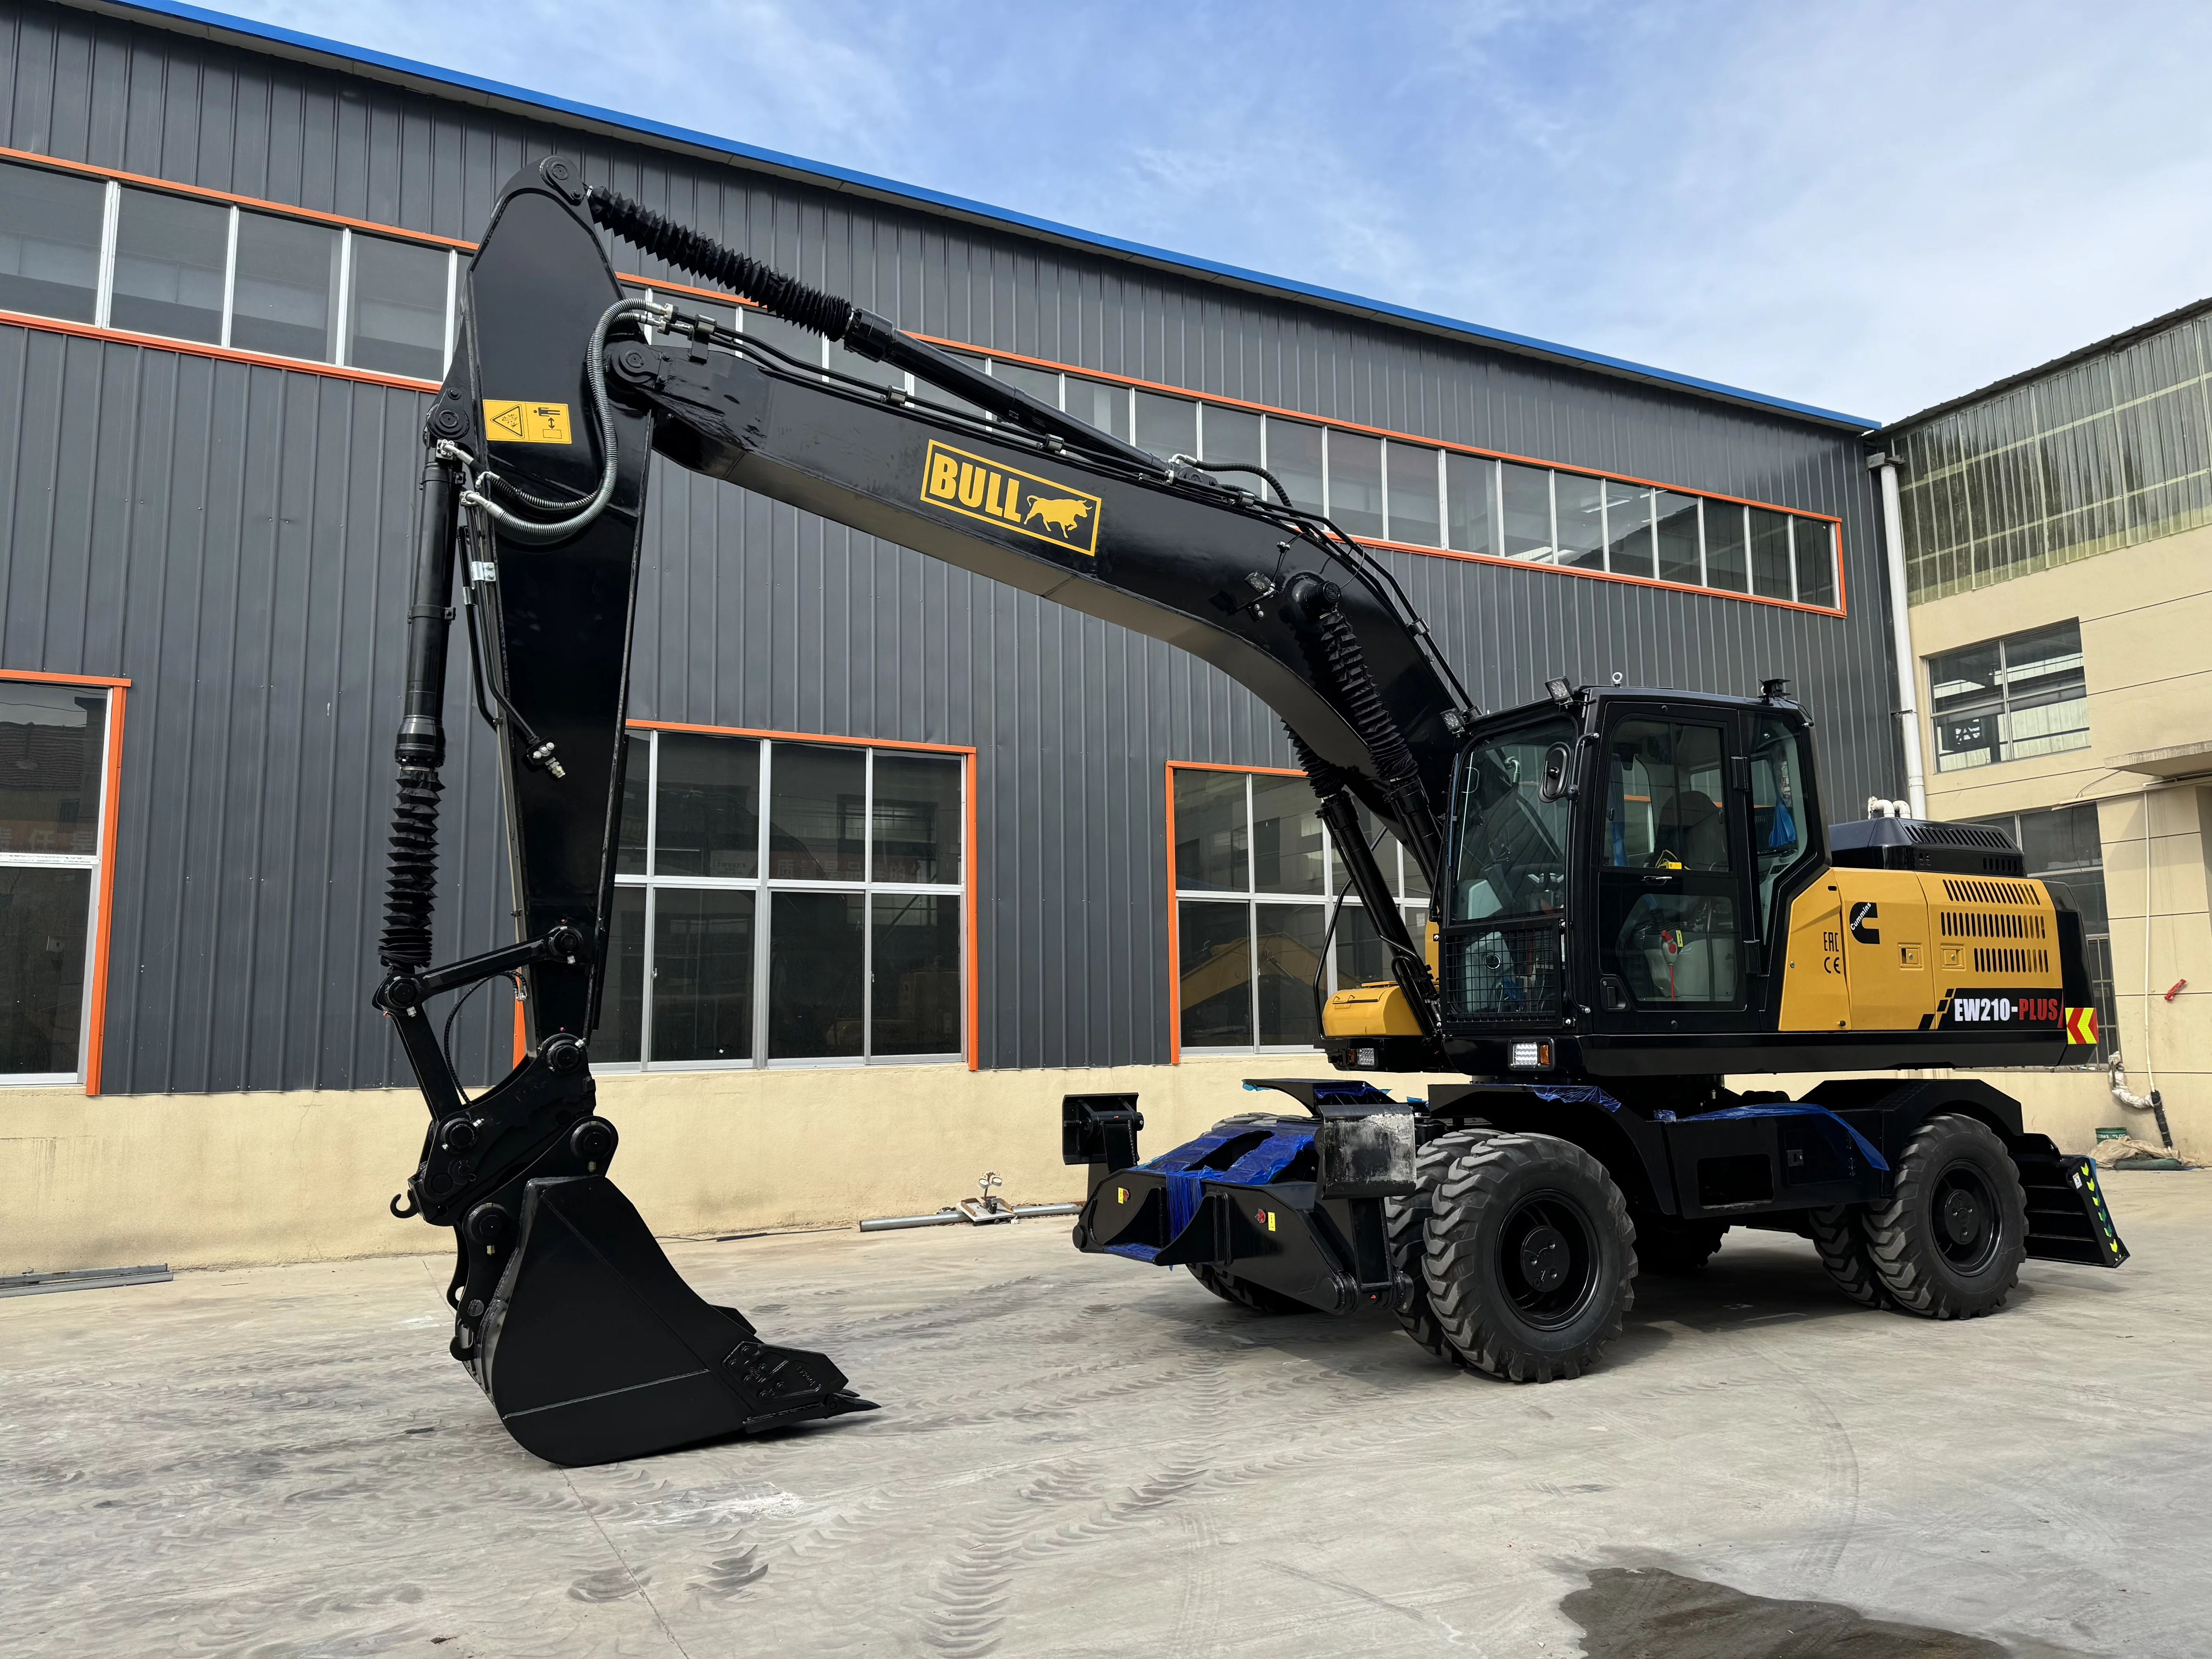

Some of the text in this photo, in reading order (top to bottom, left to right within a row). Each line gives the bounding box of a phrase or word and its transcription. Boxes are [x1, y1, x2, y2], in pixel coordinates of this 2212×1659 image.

[929, 453, 1021, 523] BULL
[1850, 902, 1871, 930] Cummins
[1824, 932, 1839, 951] EAC
[1824, 957, 1841, 974] CE
[1954, 998, 2058, 1022] EW210-PLUS
